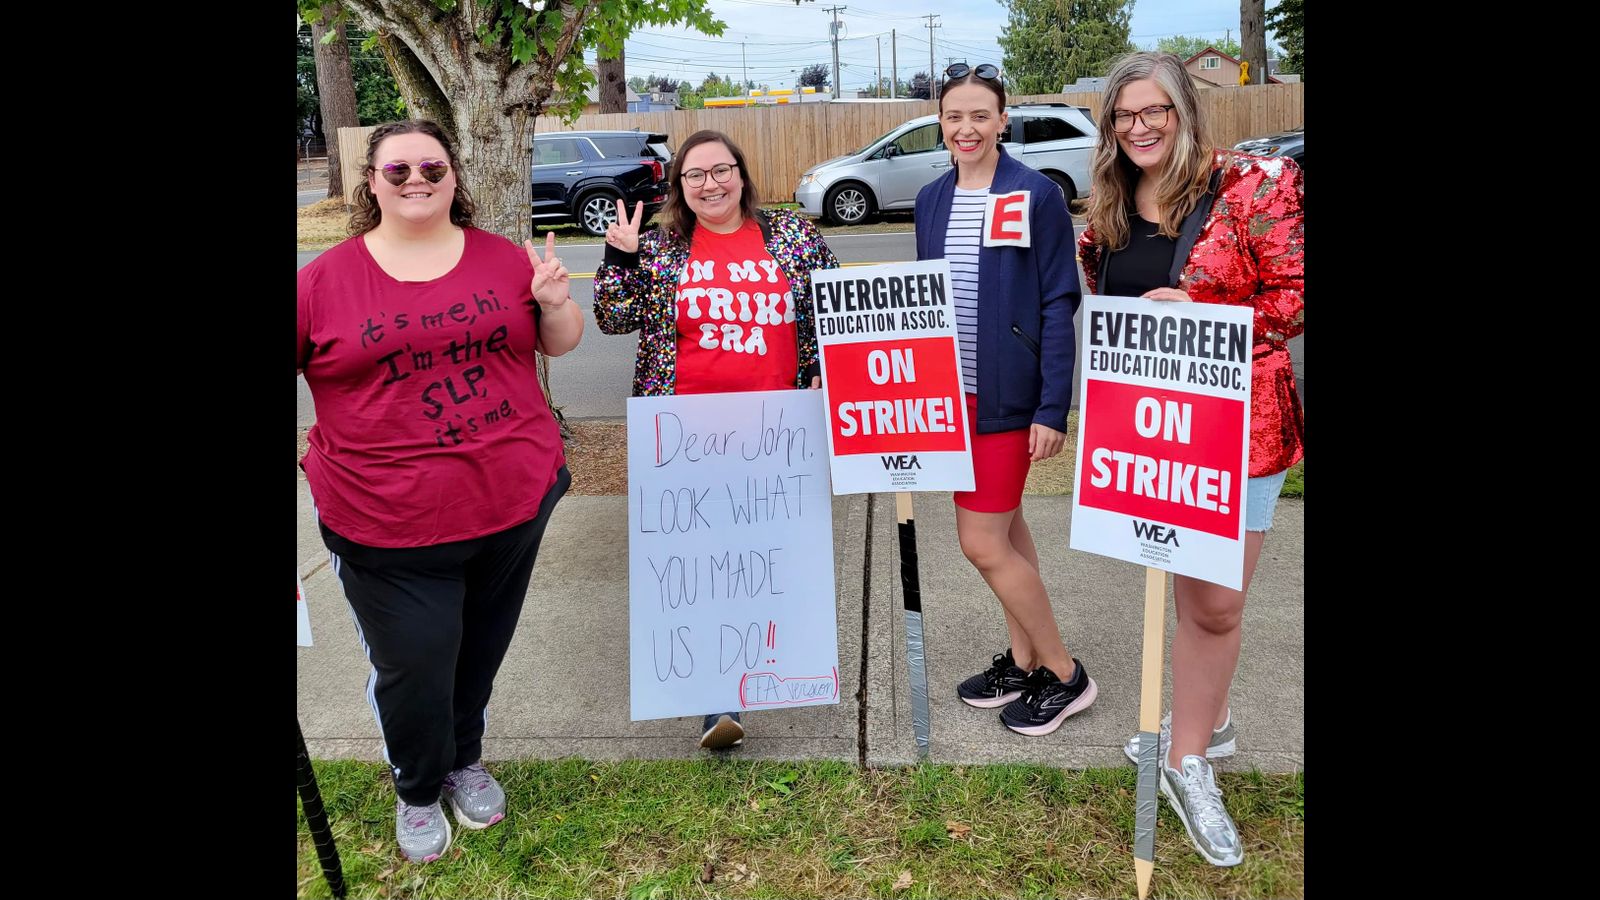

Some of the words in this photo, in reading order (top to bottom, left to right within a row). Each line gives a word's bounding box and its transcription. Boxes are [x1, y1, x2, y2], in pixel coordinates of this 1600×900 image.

[990, 194, 1025, 240] E
[726, 260, 779, 283] MY
[814, 273, 947, 315] EVERGREEN
[360, 311, 409, 348] it's
[699, 322, 768, 356] ERA
[820, 312, 896, 336] EDUCATION
[901, 309, 950, 331] ASSOC.
[1090, 311, 1247, 363] EVERGREEN
[376, 342, 433, 387] I'm
[443, 324, 509, 364] the
[867, 348, 916, 385] ON
[1090, 350, 1181, 382] EDUCATION
[1187, 362, 1246, 391] ASSOC.
[435, 414, 478, 448] it's
[484, 399, 518, 425] me.
[838, 397, 956, 437] STRIKE!
[1135, 396, 1192, 444] ON
[654, 411, 737, 468] Dear
[881, 455, 922, 470] WEA
[1090, 448, 1231, 515] STRIKE!
[640, 485, 711, 535] LOOK
[726, 474, 813, 525] WHAT
[1133, 519, 1179, 547] WEA
[648, 555, 698, 613] YOU
[710, 548, 784, 600] MADE
[652, 626, 694, 682] US
[719, 620, 776, 675] DO!!
